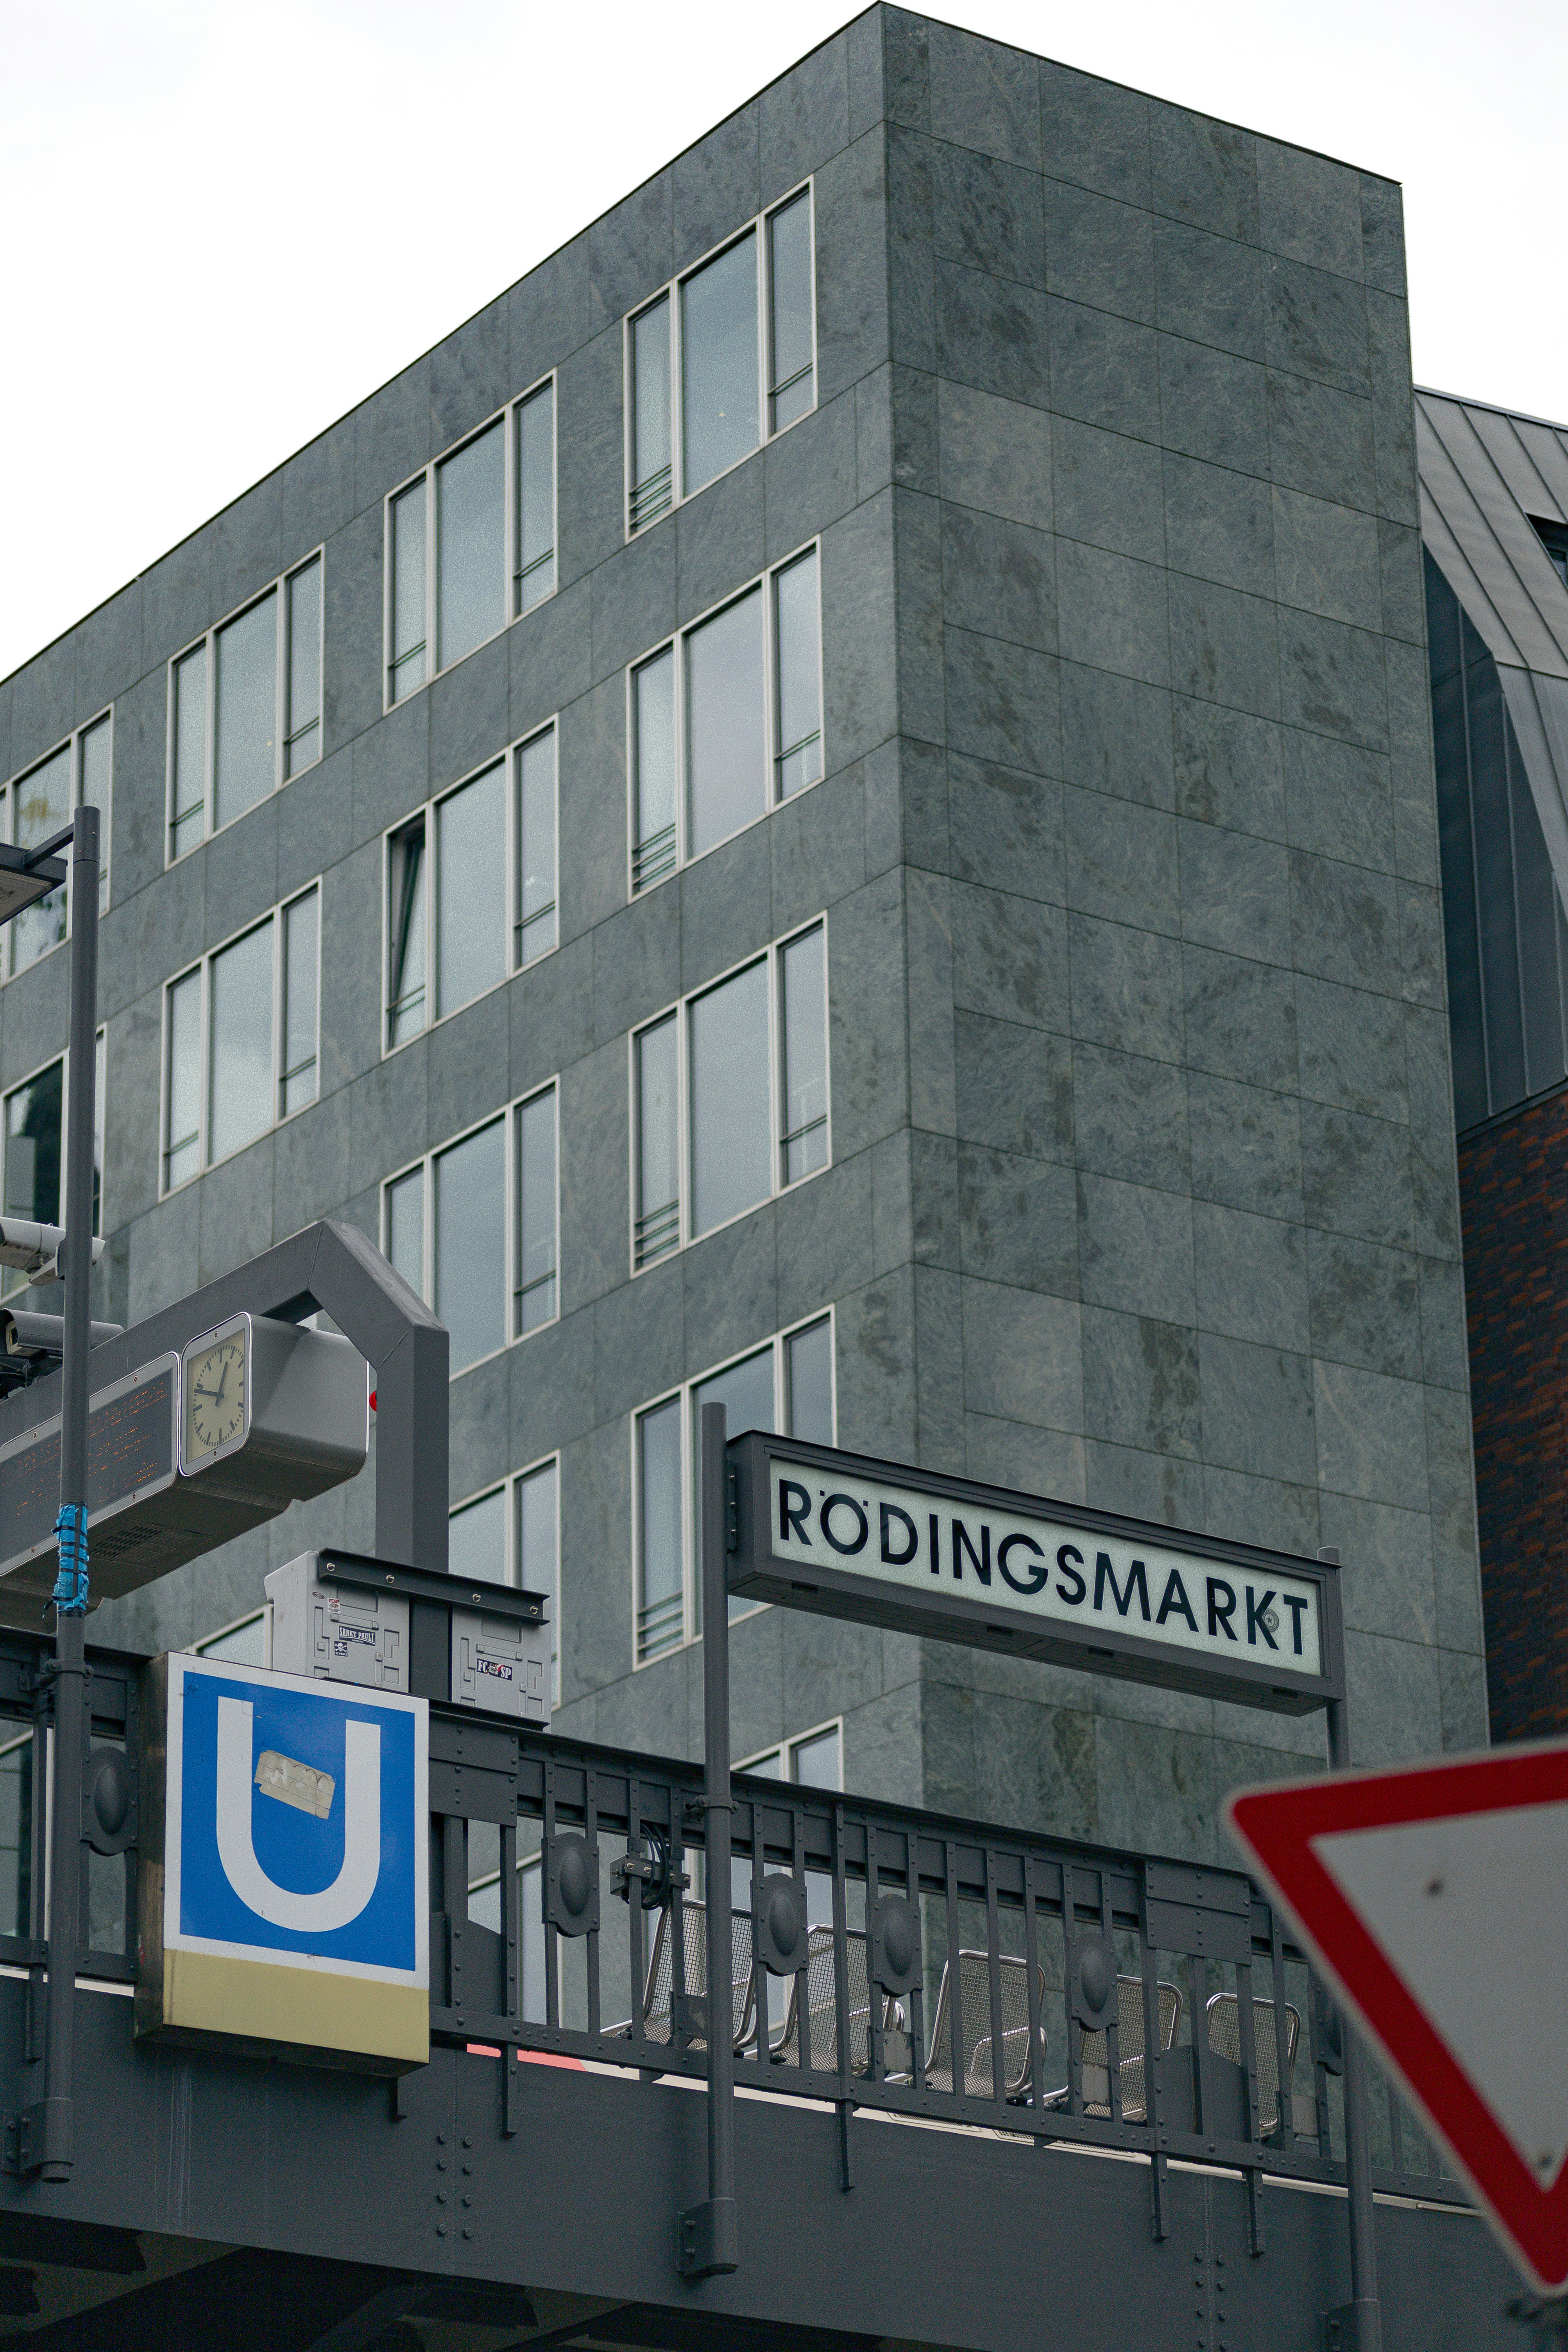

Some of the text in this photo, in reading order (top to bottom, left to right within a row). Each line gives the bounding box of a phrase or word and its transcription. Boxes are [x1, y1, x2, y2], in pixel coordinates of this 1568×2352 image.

[779, 1479, 1308, 1656] RÖDINGSMARKT
[340, 1627, 356, 1637] SANKT
[358, 1632, 374, 1642] PAULI
[478, 1660, 511, 1679] FC SP
[217, 1696, 381, 1932] U
